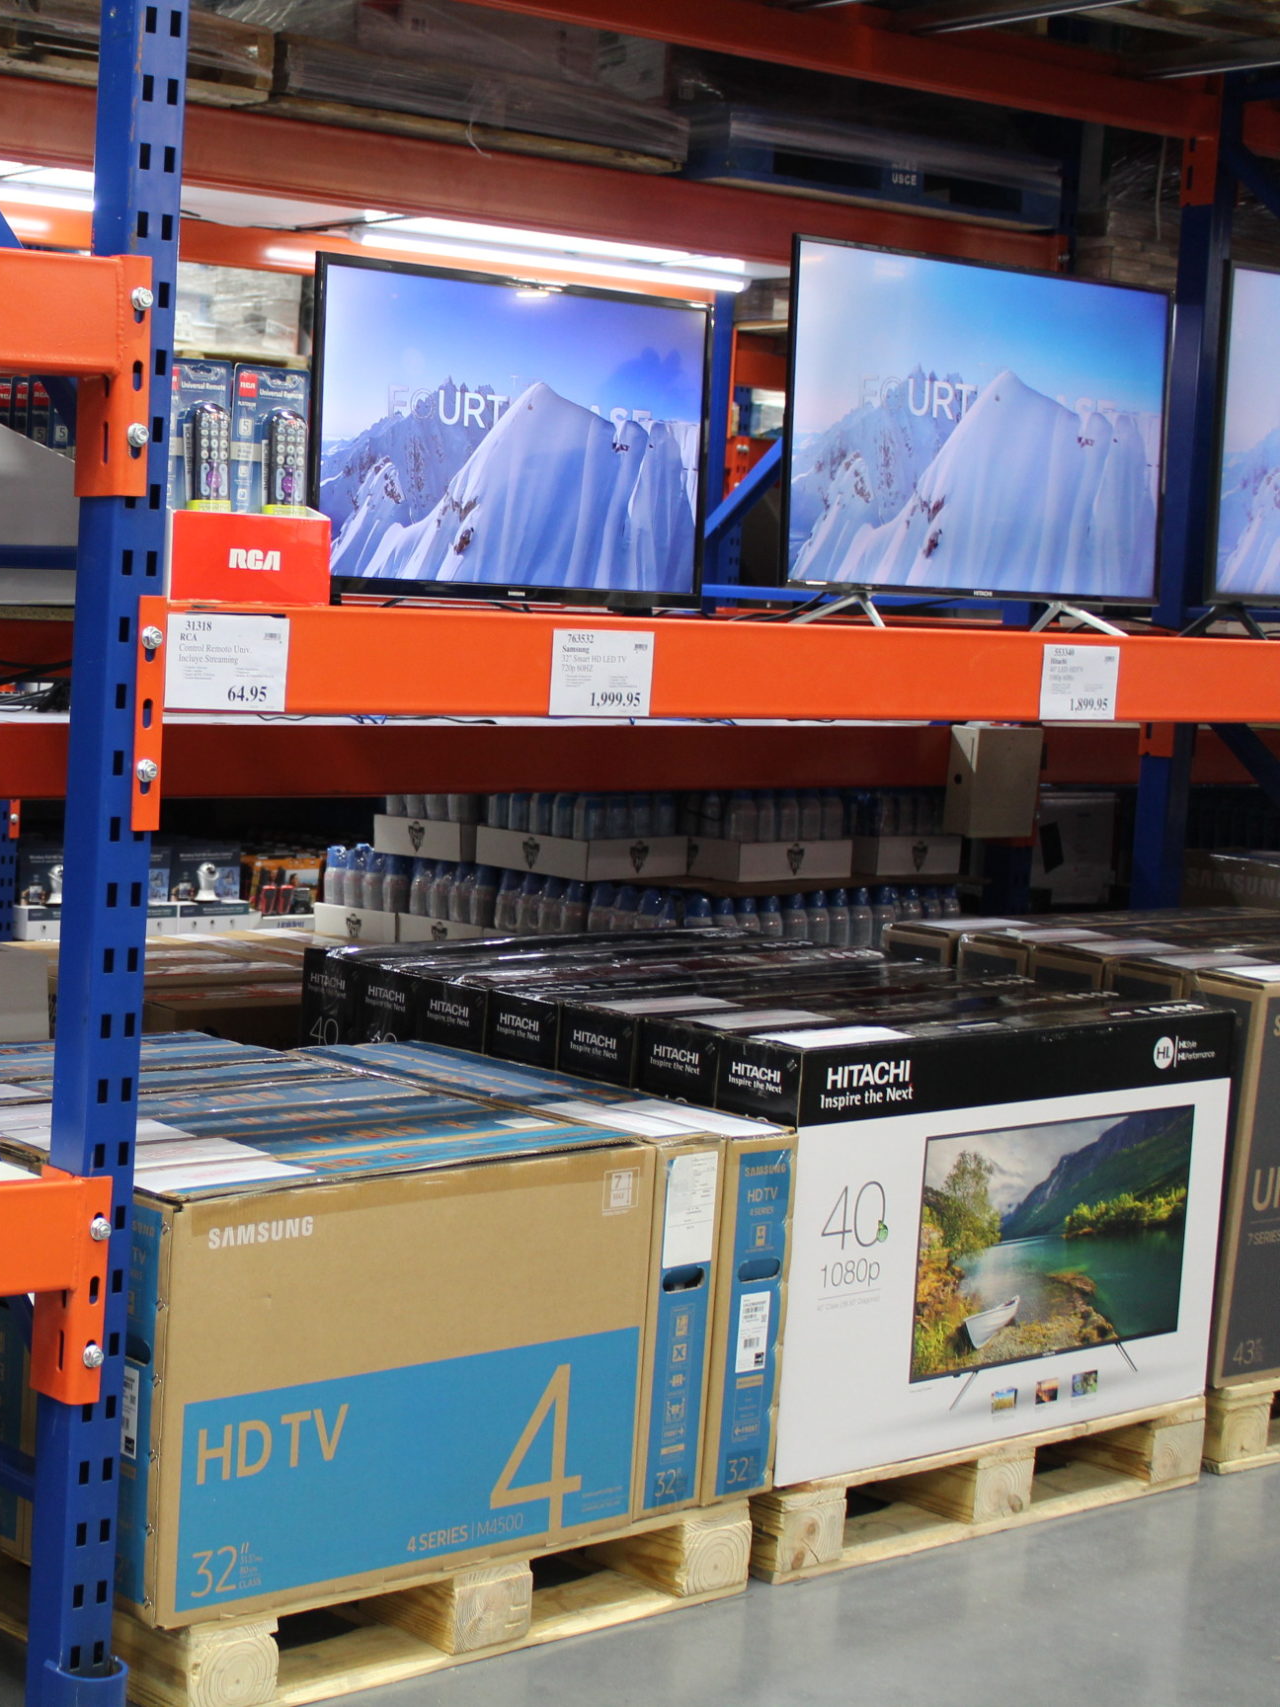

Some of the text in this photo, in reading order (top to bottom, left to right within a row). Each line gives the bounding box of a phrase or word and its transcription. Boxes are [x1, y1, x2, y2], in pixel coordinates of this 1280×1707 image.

[228, 548, 281, 572] RCA
[185, 620, 213, 632] 31318
[180, 632, 198, 642] RCA
[178, 643, 205, 652] Control
[205, 644, 233, 654] Remoto
[562, 645, 590, 654] Samsung
[178, 653, 240, 666] Incluye Streaming
[227, 685, 268, 703] 64.95
[590, 691, 641, 708] 1,999.95
[1070, 697, 1109, 712] 1,899.95
[310, 971, 346, 990] HITACHI
[367, 984, 405, 1003] HITACHI
[429, 998, 469, 1018] HITACHI
[309, 1015, 339, 1046] 40
[499, 1011, 540, 1032] HITACHI
[573, 1028, 617, 1051] HITACHI
[569, 1041, 592, 1055] Inspire
[602, 1047, 618, 1061] Next
[652, 1043, 700, 1066] HITACHI
[649, 1056, 701, 1077] Inspire the Next
[730, 1061, 782, 1084] HITACHI
[826, 1059, 911, 1090] HITACHI
[728, 1074, 783, 1095] Inspire the Next
[819, 1084, 914, 1111] Inspire the Next
[744, 1162, 787, 1177] SAMSUNG
[820, 1180, 887, 1251] 40
[208, 1215, 314, 1250] SAMSUNG
[821, 1257, 881, 1288] 1080p
[490, 1363, 582, 1532] 4
[406, 1512, 524, 1553] 4 SERIES M4500
